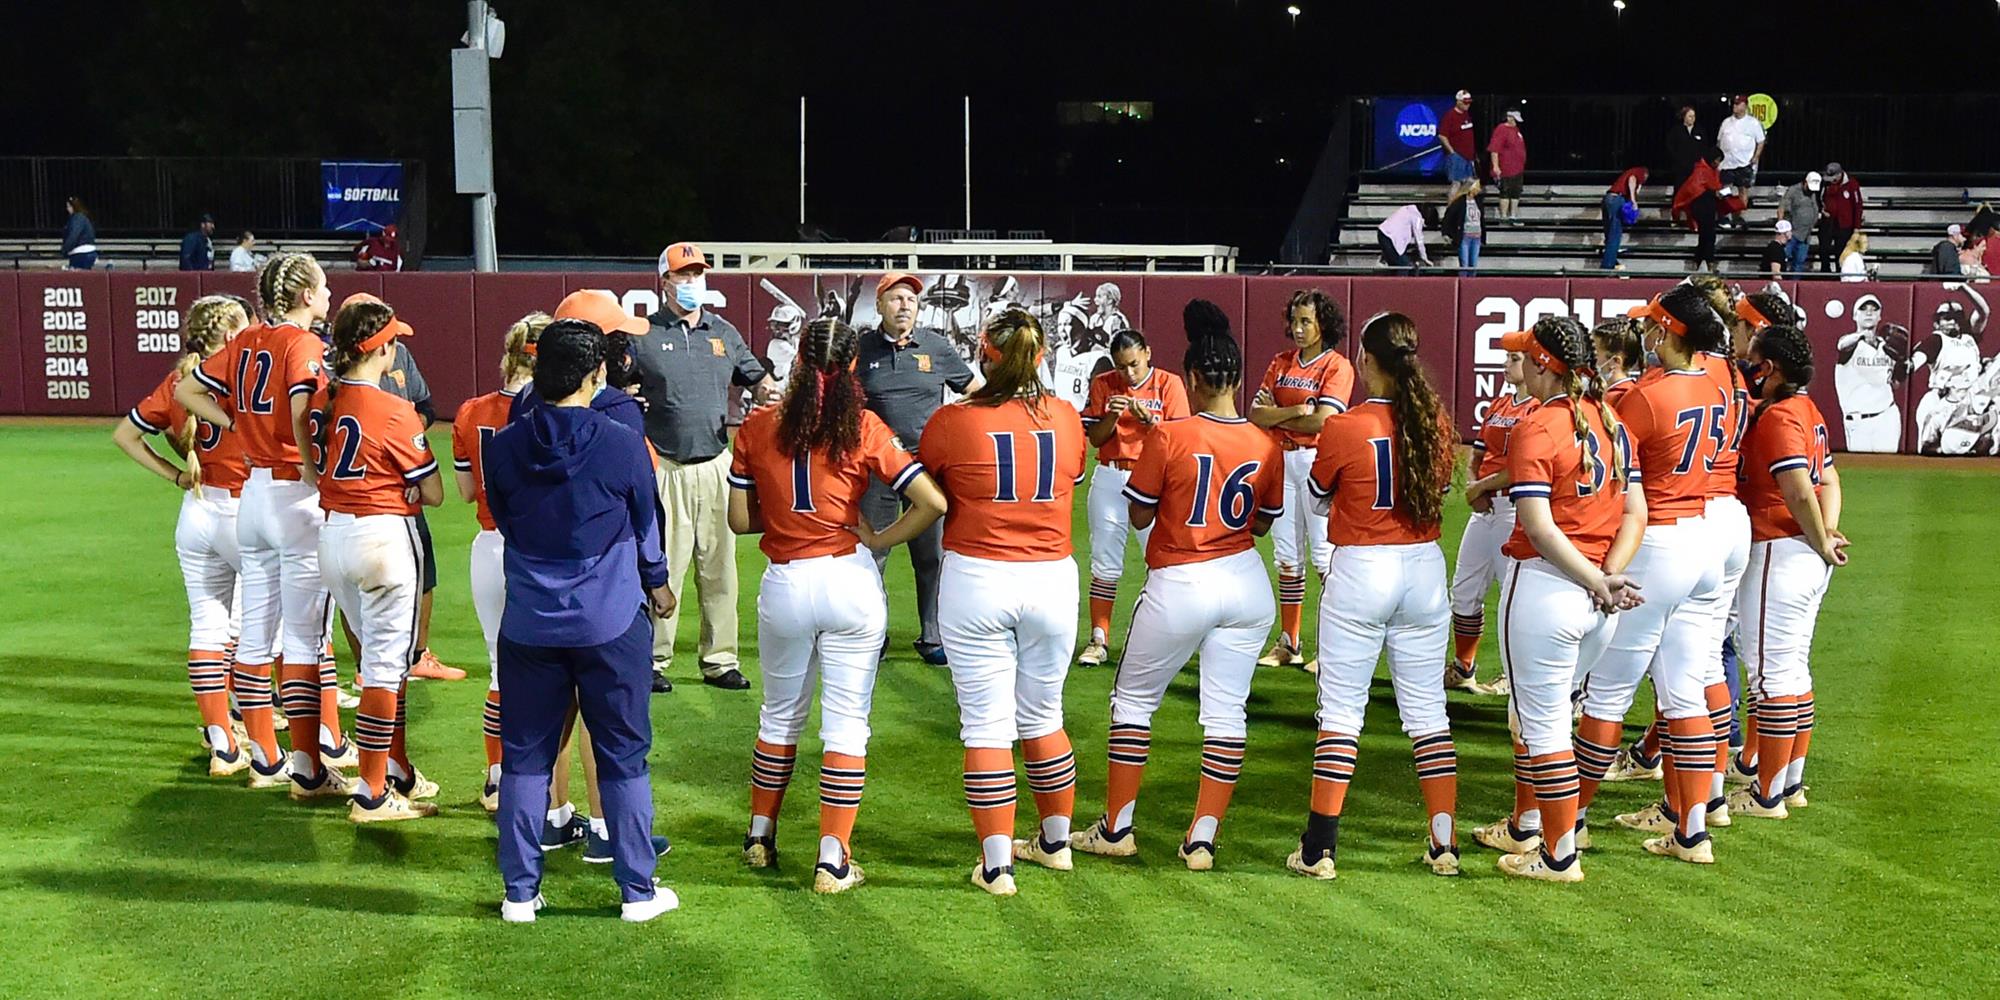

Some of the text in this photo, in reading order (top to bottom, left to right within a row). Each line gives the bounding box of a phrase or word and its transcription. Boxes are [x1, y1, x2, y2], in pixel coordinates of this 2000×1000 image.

[1400, 124, 1437, 137] NCAA
[343, 188, 400, 202] SOFTBALL
[682, 246, 695, 258] M
[44, 287, 84, 307] 2011
[135, 286, 178, 306] 2017
[43, 310, 87, 330] 2012
[136, 309, 180, 329] 2018
[44, 334, 88, 353] 2013
[137, 333, 181, 352] 2019
[45, 357, 89, 376] 2014
[47, 380, 90, 399] 2016
[236, 348, 275, 415] 12
[1072, 377, 1082, 394] 8
[309, 408, 368, 480] 32
[1672, 405, 1726, 475] 75
[985, 429, 1057, 503] 11
[1184, 453, 1262, 531] 16
